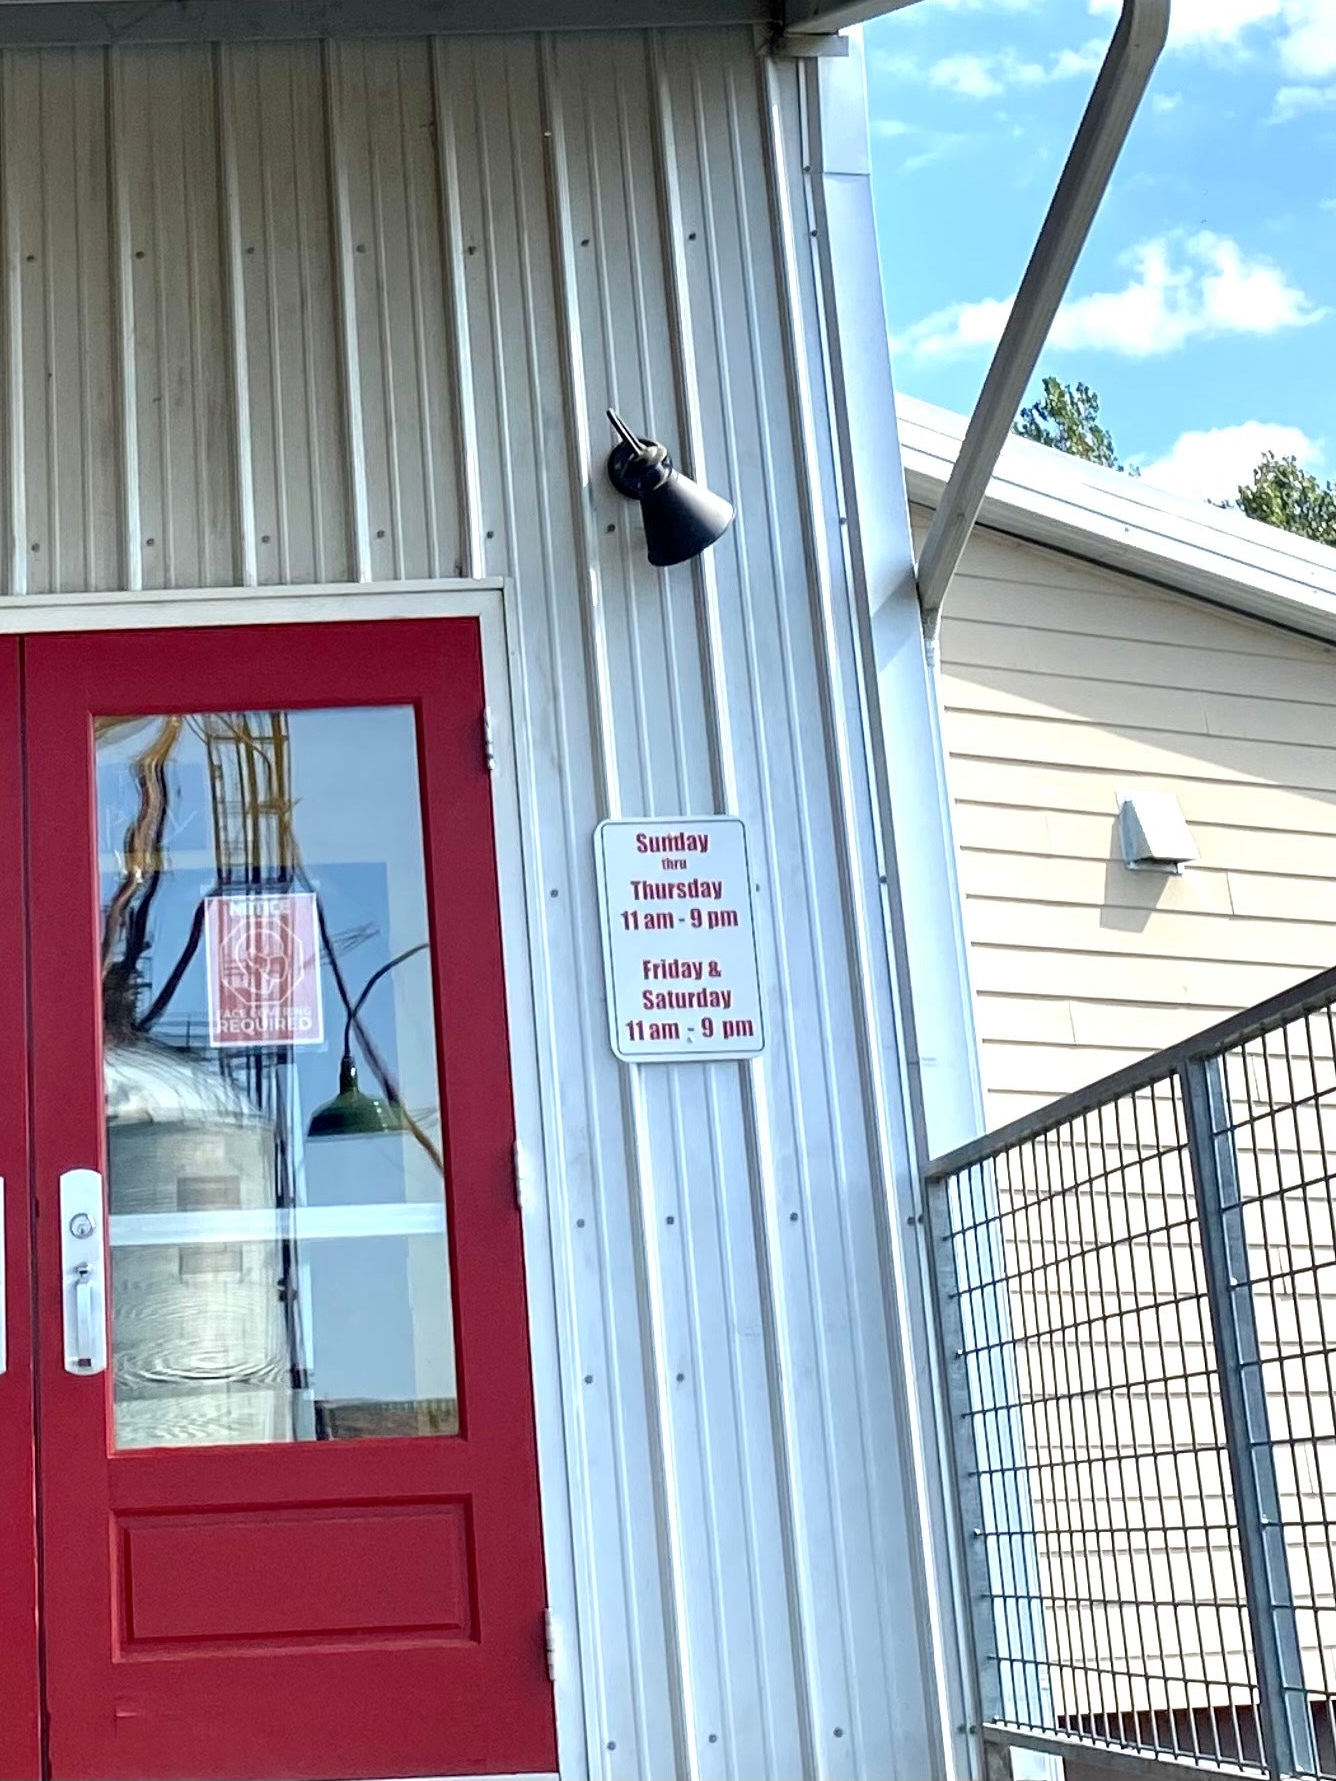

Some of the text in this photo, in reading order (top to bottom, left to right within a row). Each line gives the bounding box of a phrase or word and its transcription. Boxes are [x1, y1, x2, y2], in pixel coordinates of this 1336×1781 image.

[636, 831, 709, 854] Sunday
[661, 857, 688, 871] thru
[630, 878, 723, 901] Thursday
[642, 958, 722, 981] Friday &
[642, 987, 732, 1011] Saturday
[216, 1016, 312, 1034] REQUIRED
